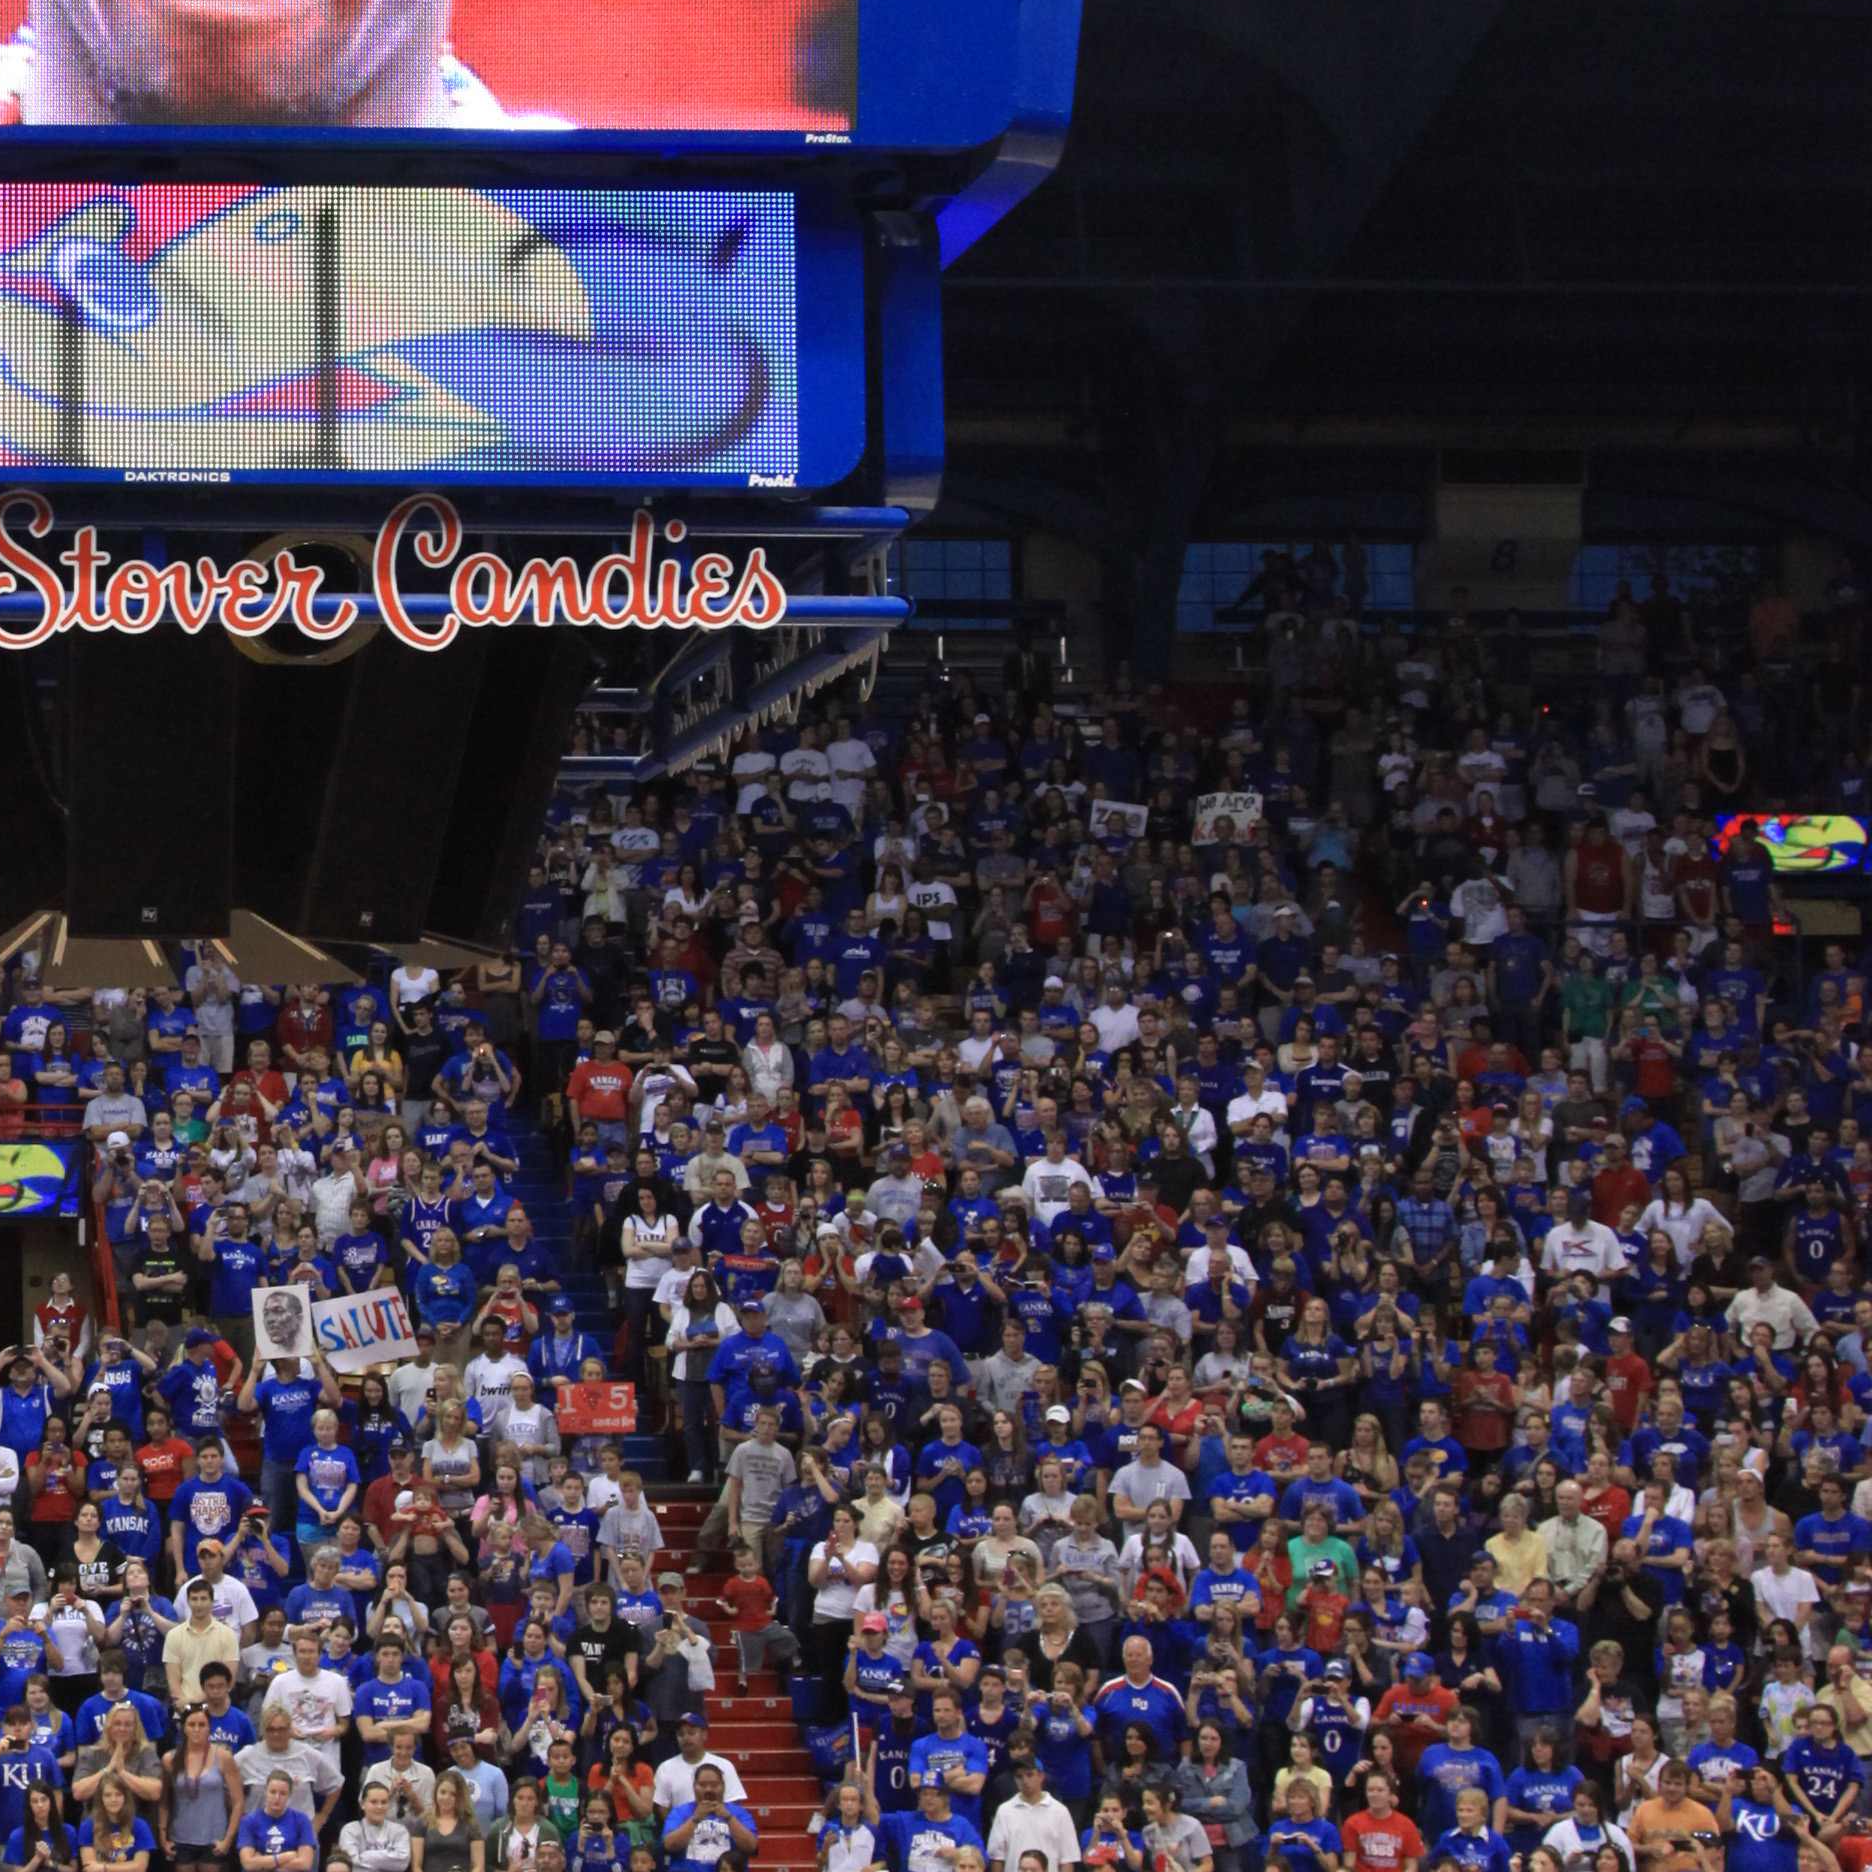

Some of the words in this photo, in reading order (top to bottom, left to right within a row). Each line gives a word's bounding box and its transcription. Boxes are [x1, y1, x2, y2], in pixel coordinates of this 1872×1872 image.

[124, 472, 230, 483] DAKTRONICS
[376, 492, 787, 652] Candies
[1230, 797, 1254, 809] Are
[1810, 1240, 1824, 1258] 0
[318, 1294, 413, 1353] SALUTE
[609, 1387, 627, 1409] 5
[884, 1402, 896, 1419] 0
[106, 1516, 148, 1535] KANSAS
[1324, 1730, 1342, 1751] 0
[3, 1763, 42, 1790] KU
[890, 1766, 904, 1789] 0
[1803, 1766, 1843, 1780] KANSAS
[1524, 1786, 1568, 1796] KANSAS
[1809, 1777, 1836, 1798] 24
[1737, 1810, 1780, 1841] KU
